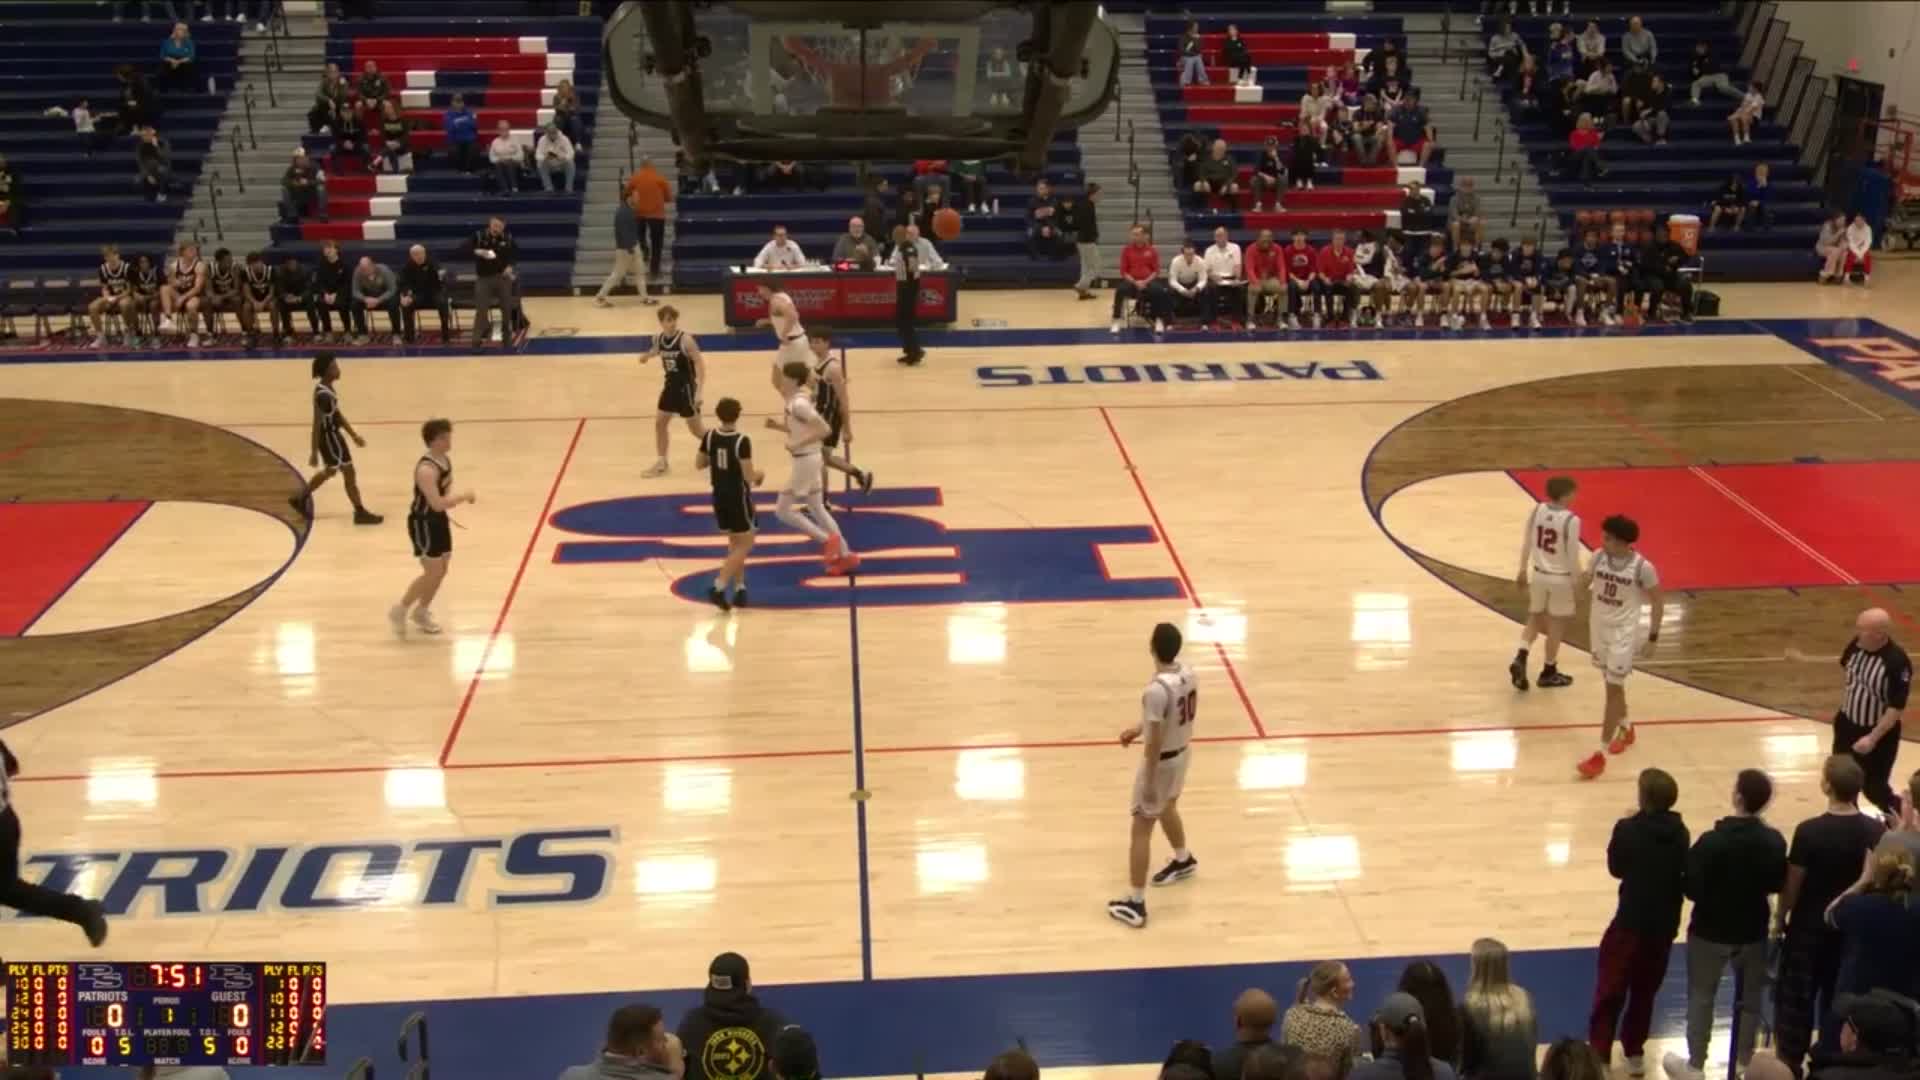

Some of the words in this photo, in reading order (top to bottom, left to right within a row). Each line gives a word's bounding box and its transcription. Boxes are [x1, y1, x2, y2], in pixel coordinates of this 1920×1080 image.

[976, 360, 1384, 387] PATRIOTS
[1536, 525, 1558, 554] 12
[1603, 582, 1617, 597] 10
[1177, 689, 1197, 726] 30
